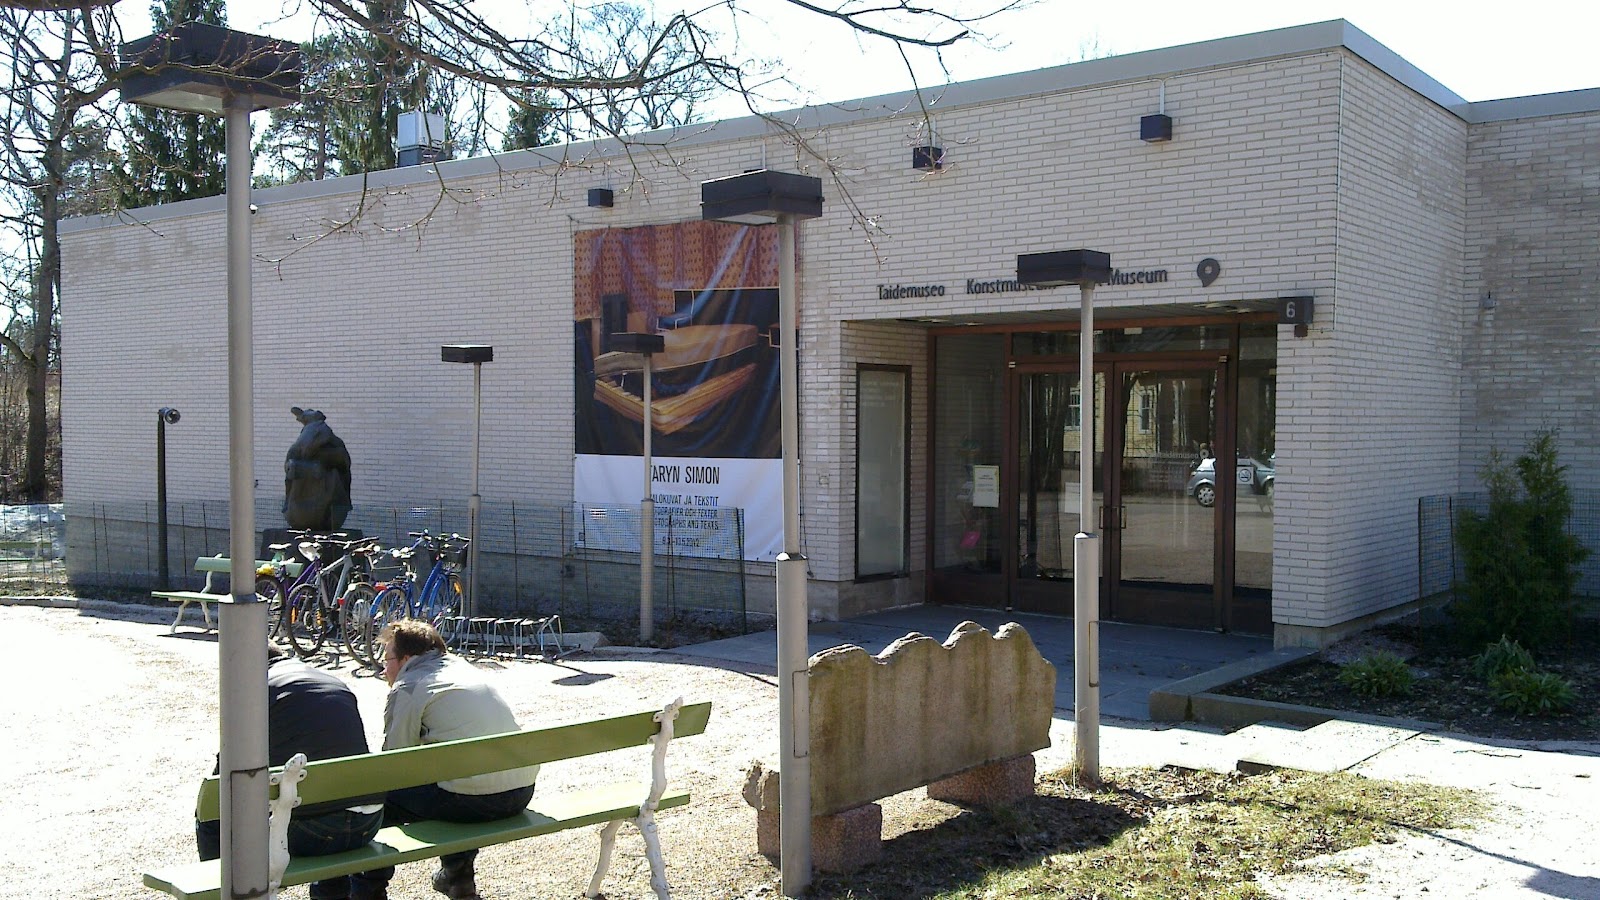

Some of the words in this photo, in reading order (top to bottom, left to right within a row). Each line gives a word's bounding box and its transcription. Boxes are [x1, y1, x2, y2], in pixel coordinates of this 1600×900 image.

[878, 284, 945, 300] Taidemuseo
[1108, 269, 1168, 286] Museum
[1286, 301, 1296, 319] 6
[651, 465, 680, 483] ARYN
[685, 466, 720, 484] SIMON
[650, 494, 682, 504] ALOKUVAT
[684, 495, 692, 505] JA
[694, 495, 719, 507] TEKSTIT
